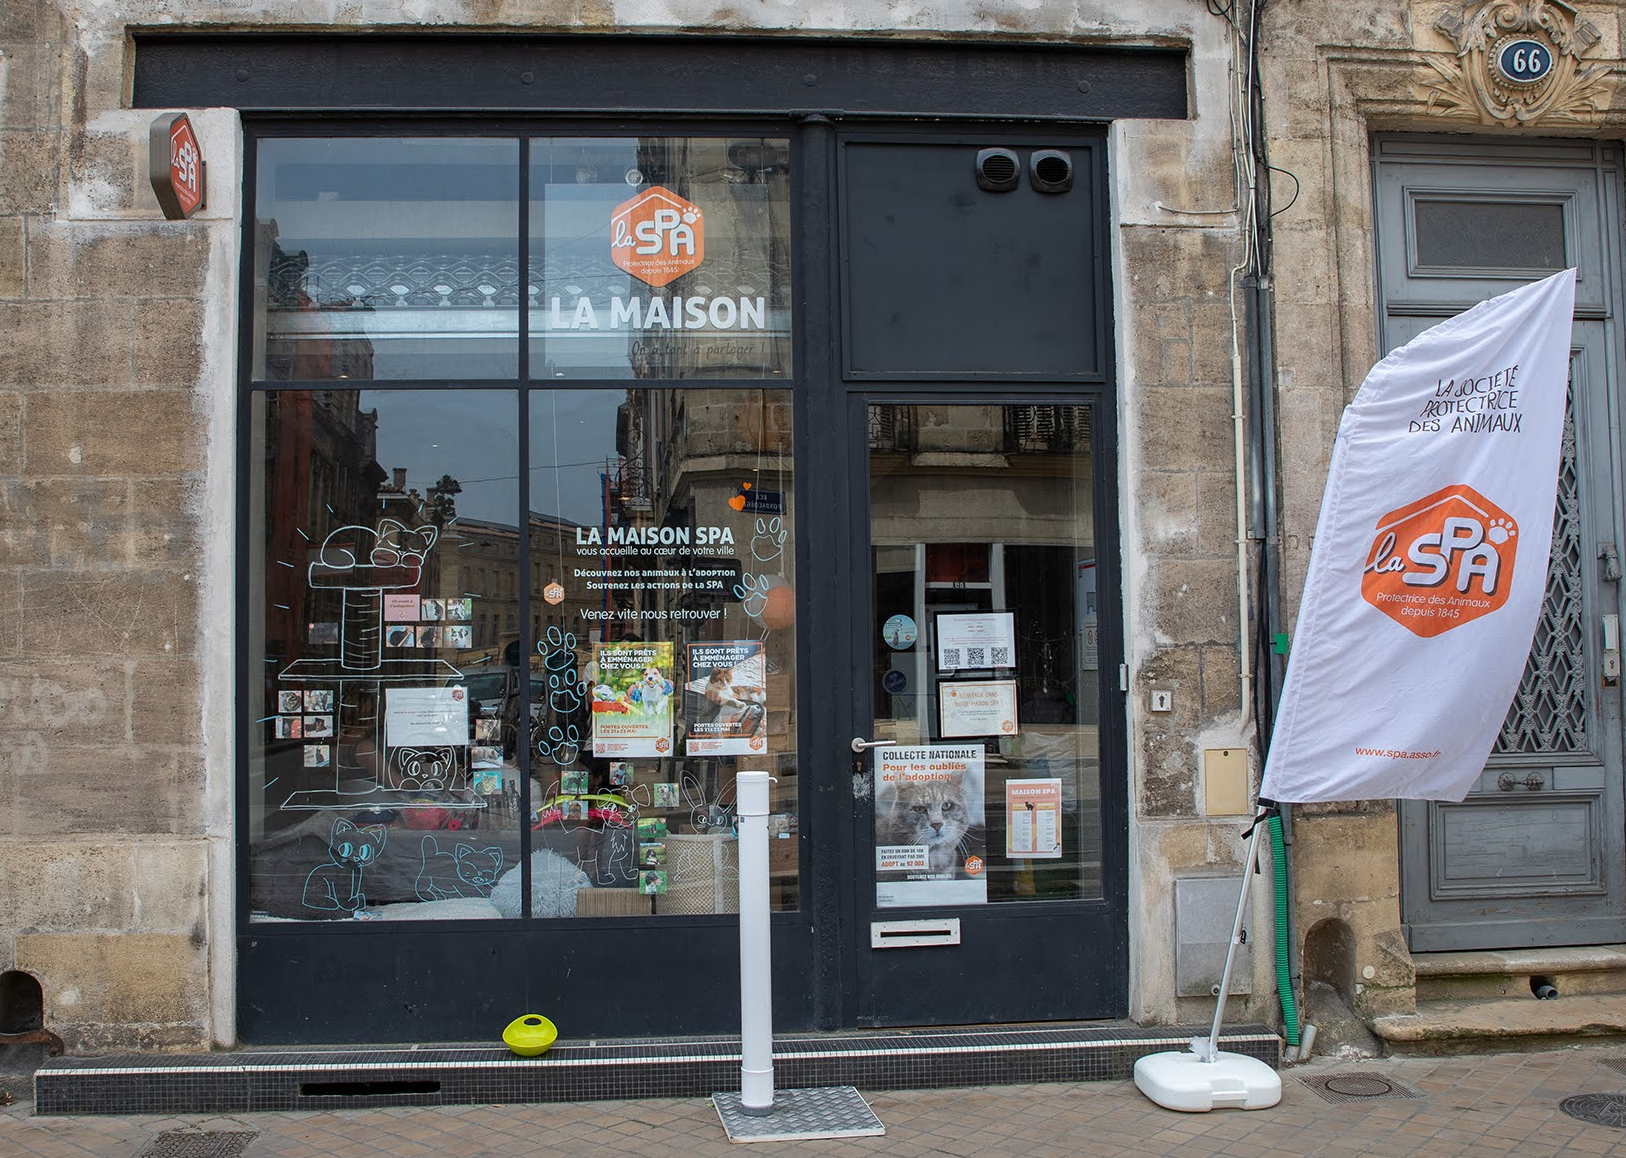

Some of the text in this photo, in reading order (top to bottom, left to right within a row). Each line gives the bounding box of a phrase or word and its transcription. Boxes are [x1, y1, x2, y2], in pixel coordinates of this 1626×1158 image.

[1513, 49, 1541, 73] 66
[179, 141, 196, 194] SPA
[611, 209, 696, 256] la SPA
[551, 296, 765, 330] LA MAISON
[631, 340, 646, 355] On
[651, 345, 660, 355] a
[666, 342, 688, 355] tant
[694, 344, 700, 355] à
[706, 342, 756, 360] partager
[1435, 379, 1454, 398] LA
[1420, 390, 1518, 418] PROTECTRICE
[1408, 412, 1522, 434] DES ANIMAUX
[576, 526, 735, 545] LA MAISON SPA
[576, 546, 735, 556] vous accueille au cœur de votre ville
[1364, 516, 1502, 596] la SPA
[574, 569, 622, 577] Découvrez
[681, 568, 687, 577] à
[706, 580, 724, 589] SPA
[1376, 592, 1491, 608] Protectrice des Animaux
[580, 607, 727, 620] Venez vite nous retrouver !
[1400, 606, 1460, 619] depuis 1845
[883, 750, 976, 760] COLLECTE NATIONALE
[1355, 747, 1441, 760] www.spa.assofr
[929, 762, 966, 770] oubliés
[899, 773, 951, 782] l'adoption
